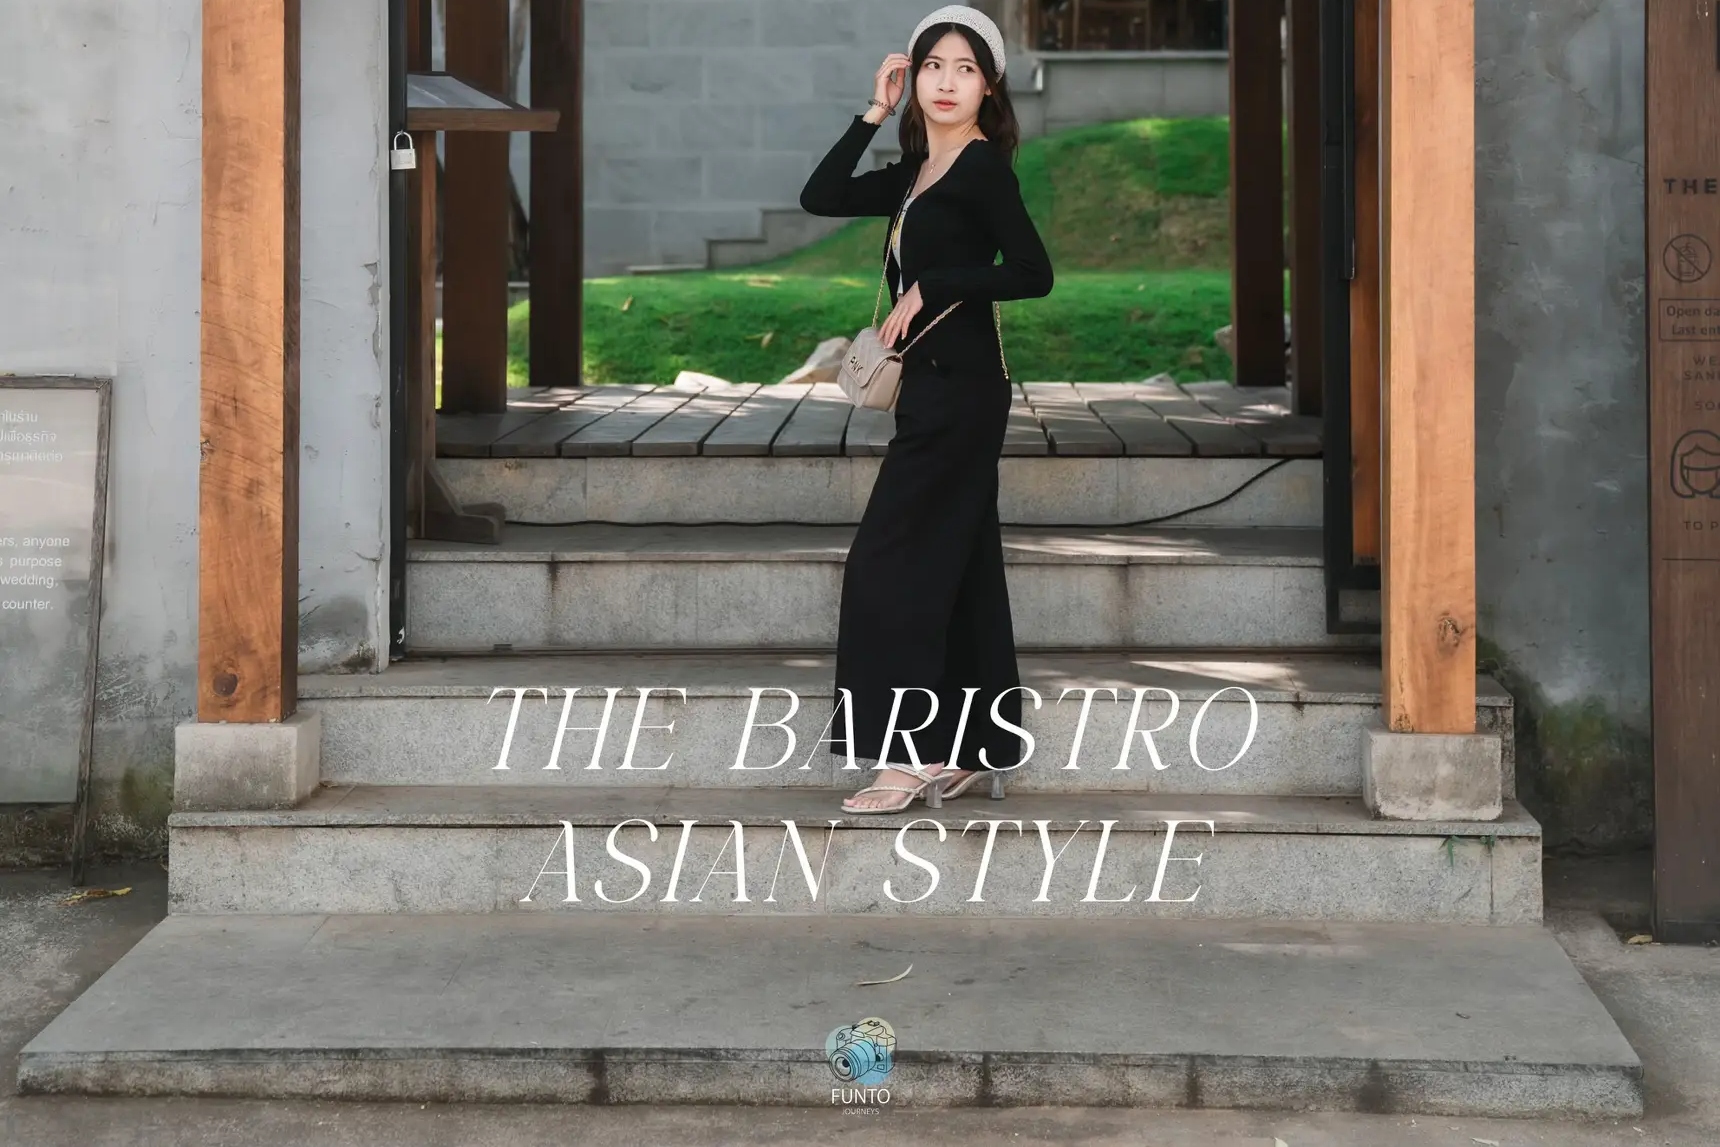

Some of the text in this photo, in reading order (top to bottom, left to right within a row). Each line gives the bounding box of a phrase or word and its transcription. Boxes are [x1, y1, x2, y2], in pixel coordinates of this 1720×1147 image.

[1663, 178, 1718, 195] THE
[1666, 305, 1700, 319] Open
[1671, 324, 1696, 336] Last
[1693, 355, 1720, 367] WE
[1683, 521, 1703, 530] TO
[22, 537, 70, 550] anyone
[9, 557, 62, 569] purpose
[0, 573, 59, 589] wedding,
[2, 599, 54, 610] counter.
